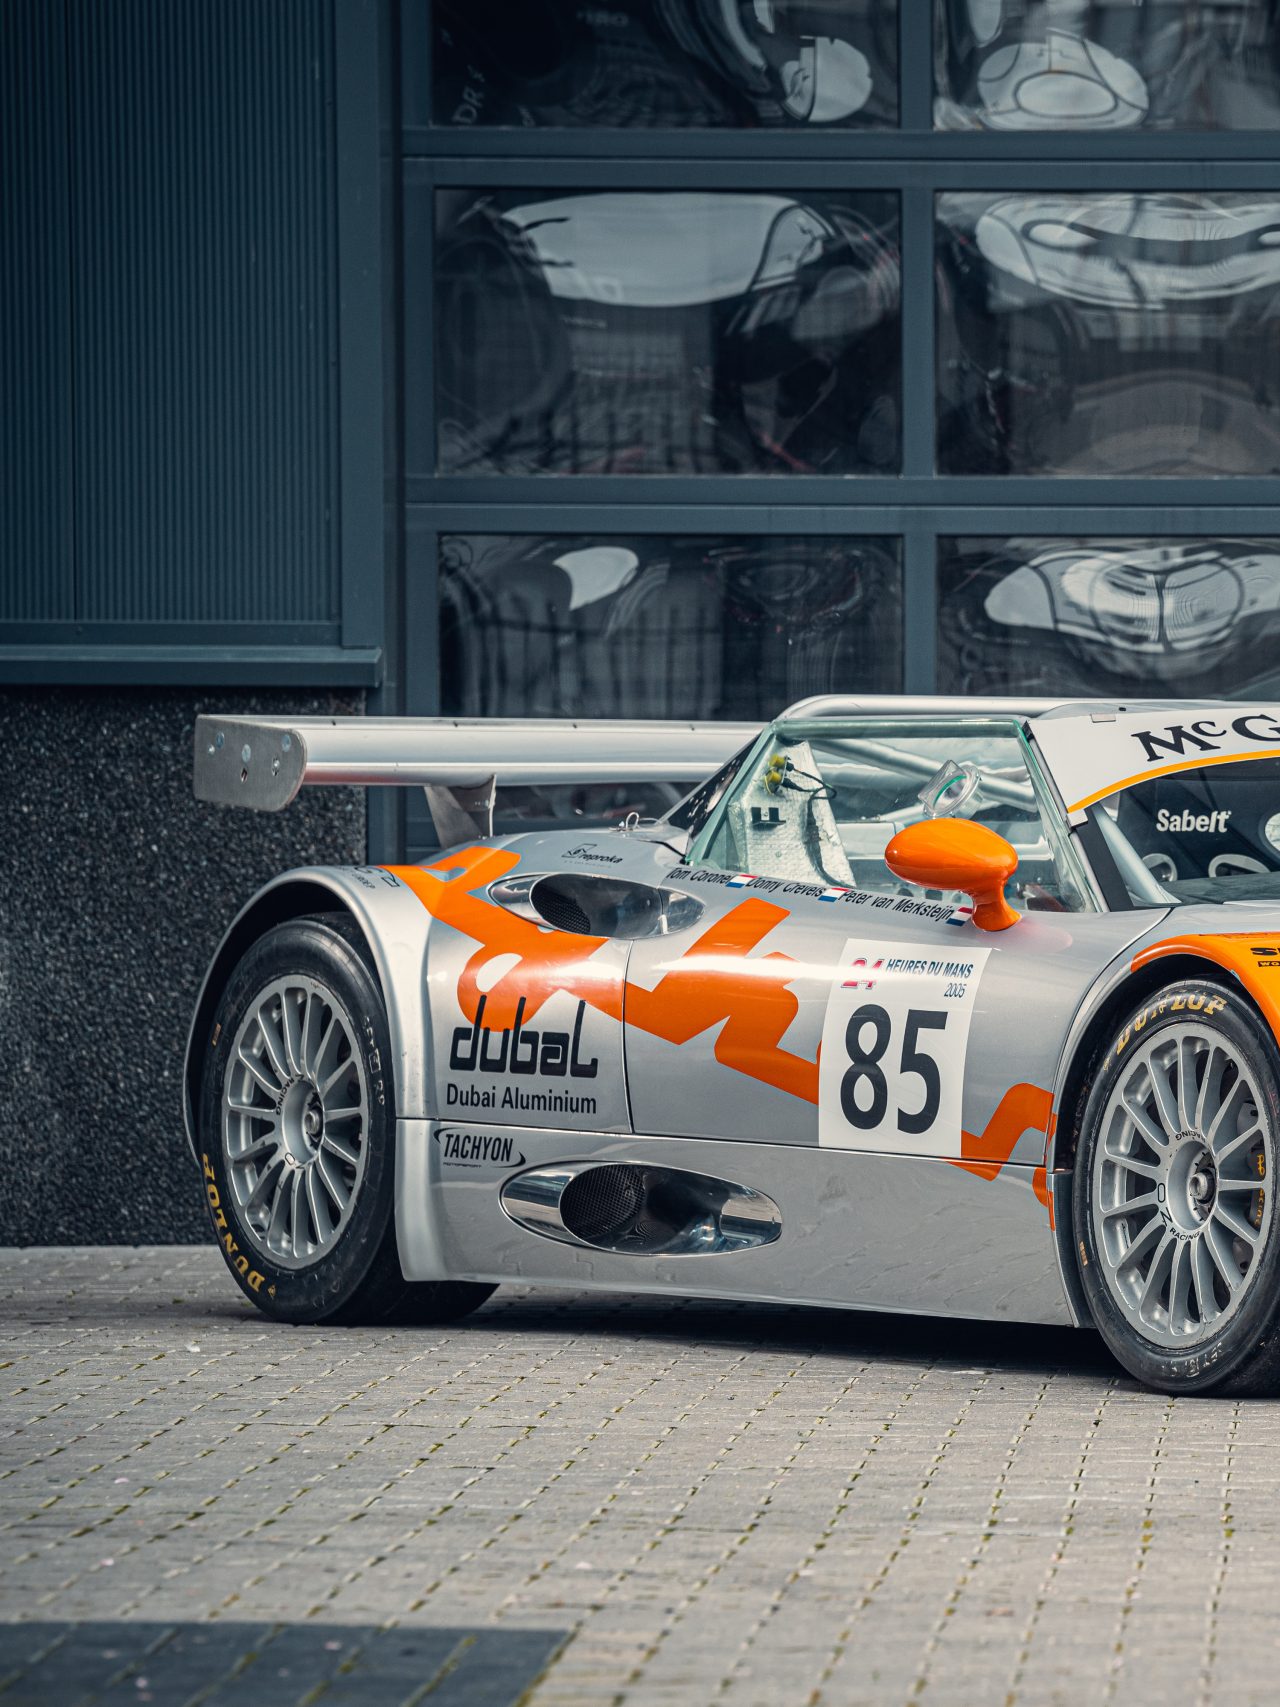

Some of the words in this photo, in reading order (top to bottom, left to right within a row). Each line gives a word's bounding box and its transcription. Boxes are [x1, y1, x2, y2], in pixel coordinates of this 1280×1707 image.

[1156, 808, 1231, 833] Sabelt
[666, 867, 691, 879] Tom
[690, 869, 733, 885] Coronel
[745, 876, 783, 893] Donny
[783, 882, 827, 898] Crevels
[838, 889, 872, 905] Peter
[871, 896, 893, 908] van
[892, 899, 955, 922] Merksteijn
[886, 957, 926, 975] HEURES
[927, 961, 943, 977] DU
[942, 962, 974, 979] MANS
[944, 982, 967, 999] 2005
[840, 1003, 949, 1135] 85
[446, 1082, 497, 1109] Dubai
[501, 1086, 598, 1115] Aluminium
[444, 1133, 514, 1162] TACHYON
[201, 1152, 267, 1295] DUNLOP
[1169, 1227, 1202, 1241] RACING
